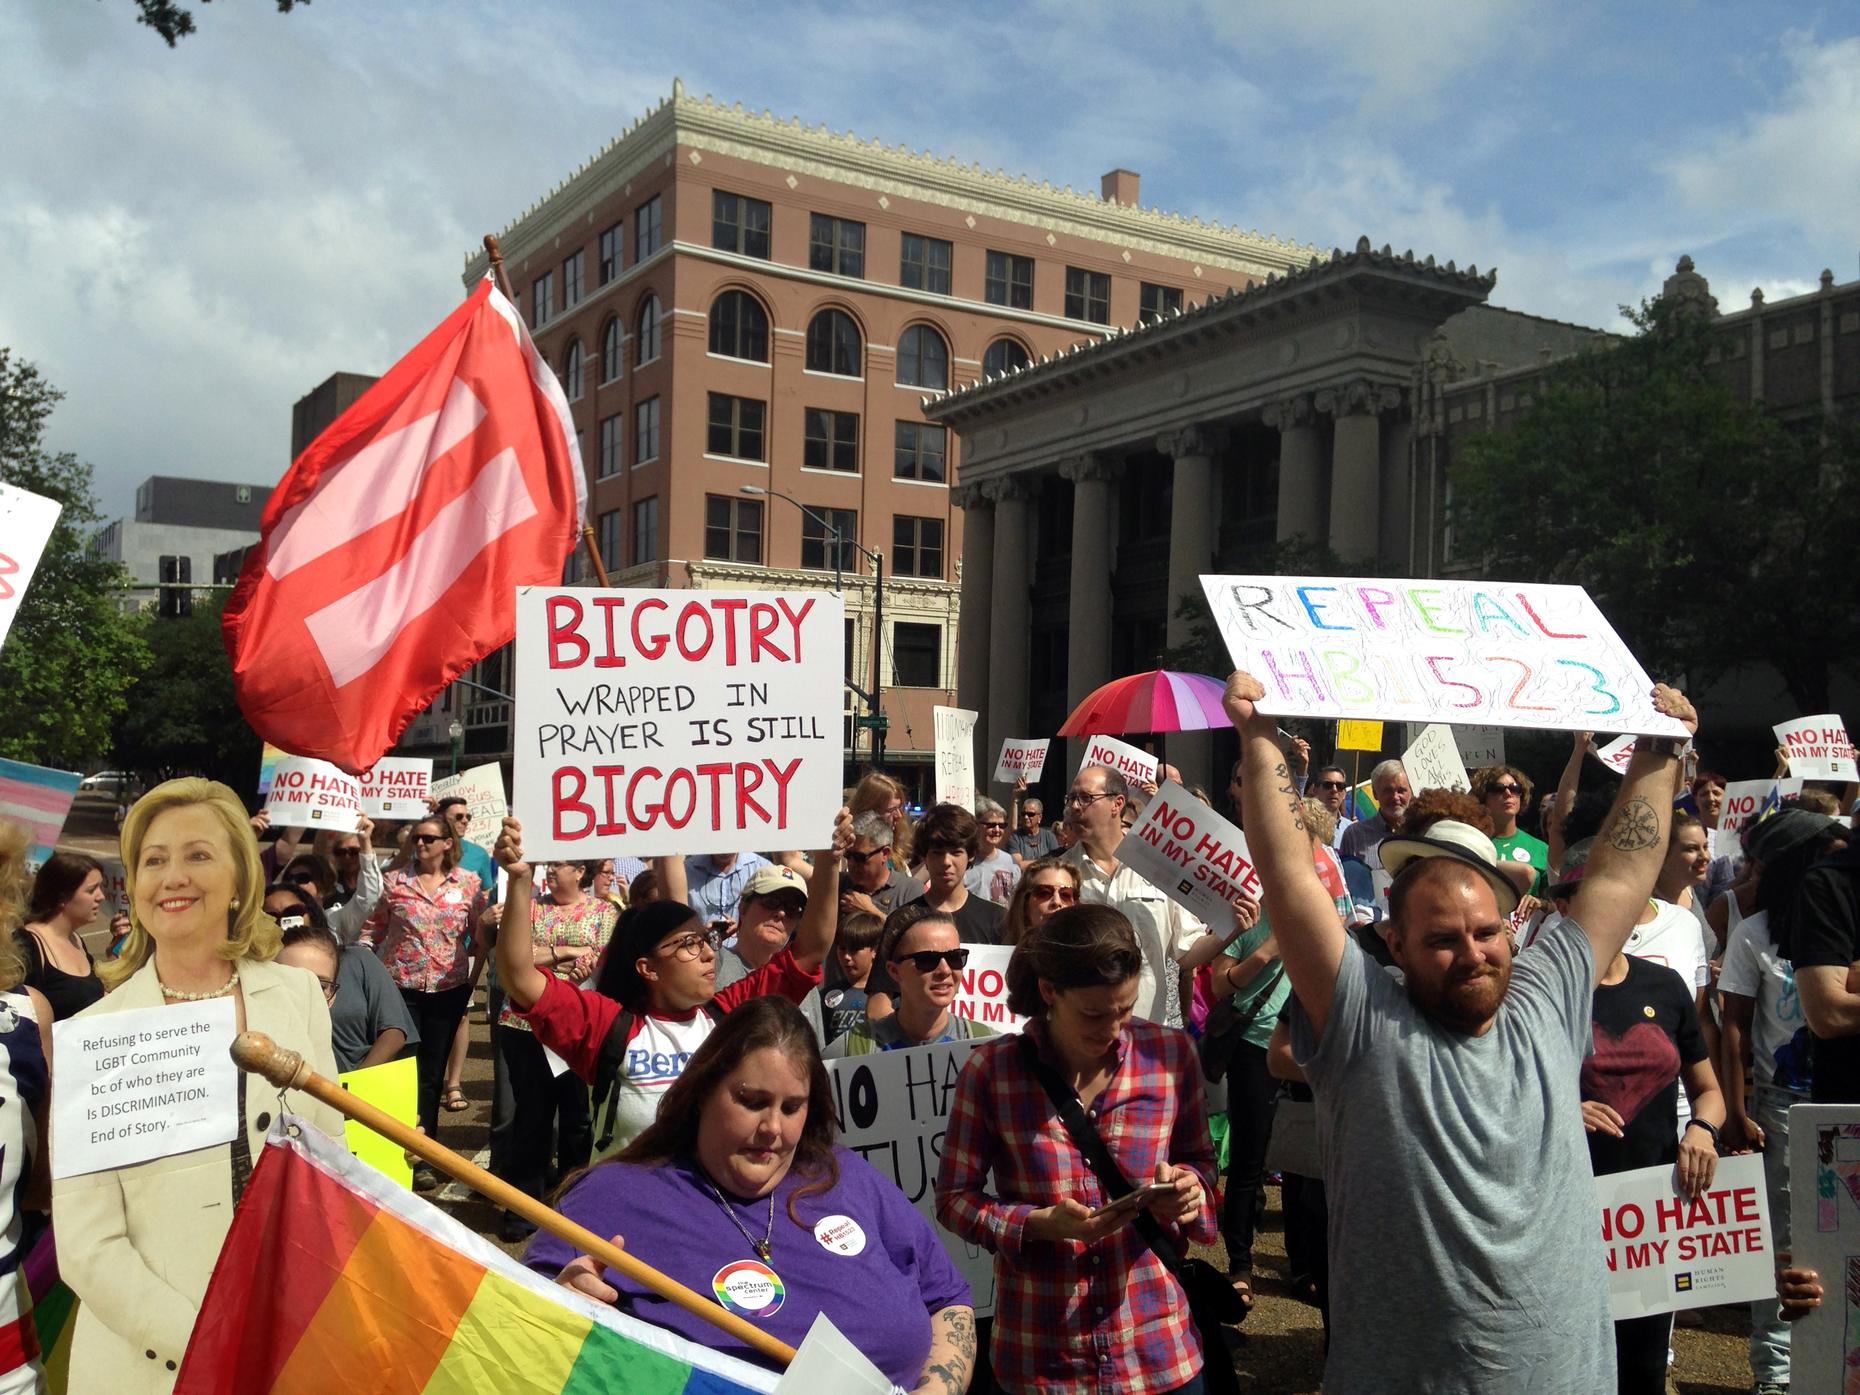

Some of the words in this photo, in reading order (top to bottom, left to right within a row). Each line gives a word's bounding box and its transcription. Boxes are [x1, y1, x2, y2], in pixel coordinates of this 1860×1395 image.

[1230, 584, 1588, 640] REPEAL
[545, 594, 816, 669] BIGOTRY
[556, 683, 695, 716] WRAPPED
[726, 682, 768, 707] IN
[538, 721, 664, 758] PRAYER
[689, 718, 733, 746] IS
[747, 716, 825, 743] STILL
[1414, 729, 1437, 758] GOD
[1786, 729, 1818, 746] NO
[1822, 728, 1850, 746] HAT
[1001, 760, 1012, 768] IN
[1013, 761, 1027, 769] MY
[1004, 747, 1024, 760] NO
[1025, 748, 1046, 760] HATE
[1091, 744, 1116, 765] NO
[1117, 755, 1154, 780] HATE
[1791, 748, 1807, 758] IN
[1810, 746, 1829, 758] MY
[274, 771, 305, 788] NO
[310, 773, 358, 800] HATE
[379, 770, 428, 786] HATE
[270, 790, 284, 803] IN
[287, 791, 315, 805] MY
[318, 793, 361, 812] STATE
[361, 787, 383, 798] MY
[387, 787, 427, 799] STATE
[551, 758, 803, 840] BIGOTRY
[1727, 796, 1755, 815] NO
[1724, 818, 1737, 830] IN
[1138, 822, 1164, 847] IN
[1161, 839, 1196, 868] MY
[1152, 801, 1195, 841] NO
[1194, 832, 1262, 896] HATE
[960, 968, 1004, 997] NO
[950, 999, 975, 1020] IN
[83, 1033, 136, 1051] Refusing
[139, 1031, 152, 1043] to
[155, 1027, 188, 1041] serve
[190, 1021, 211, 1033] the
[95, 1055, 127, 1072] LGBT
[131, 1044, 201, 1065] Community
[627, 1049, 693, 1077] Ber
[91, 1082, 106, 1096] bc
[110, 1078, 123, 1092] of
[126, 1075, 153, 1090] who
[156, 1069, 183, 1085] they
[186, 1065, 205, 1078] are
[101, 1086, 210, 1118] DISCRIMINATION.
[91, 1127, 115, 1144] End
[118, 1122, 132, 1138] of
[135, 1119, 170, 1136] Story.
[1601, 1203, 1645, 1242] NO
[1655, 1186, 1761, 1234] HATE
[1625, 1240, 1670, 1270] MY
[1678, 1227, 1764, 1261] STATE
[726, 1282, 773, 1292] spectrum
